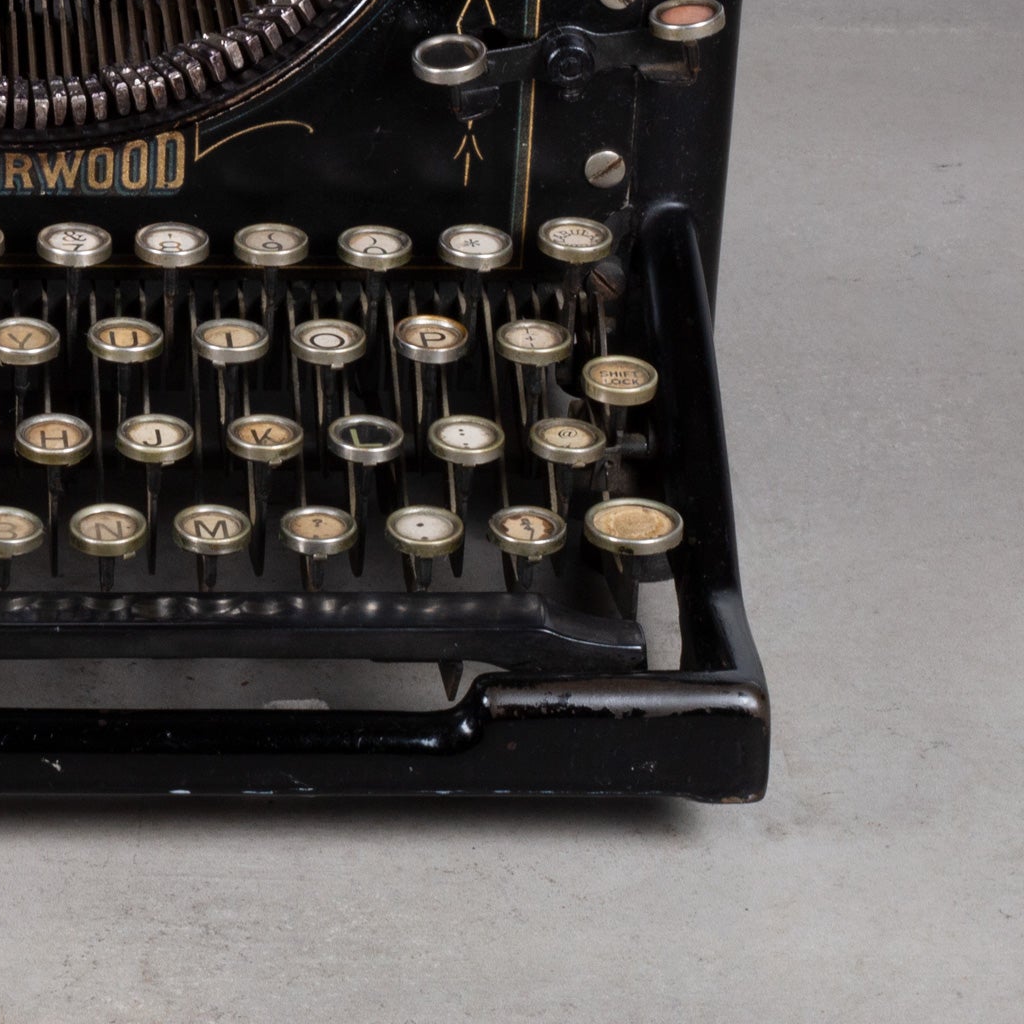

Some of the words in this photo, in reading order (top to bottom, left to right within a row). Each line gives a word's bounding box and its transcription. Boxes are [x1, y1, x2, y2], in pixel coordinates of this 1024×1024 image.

[7, 332, 32, 350] Y
[308, 332, 346, 349] O
[419, 330, 446, 348] P
[39, 429, 70, 449] H
[142, 428, 163, 447] J
[250, 427, 286, 446] K
[94, 521, 123, 539] N
[193, 519, 229, 538] M
